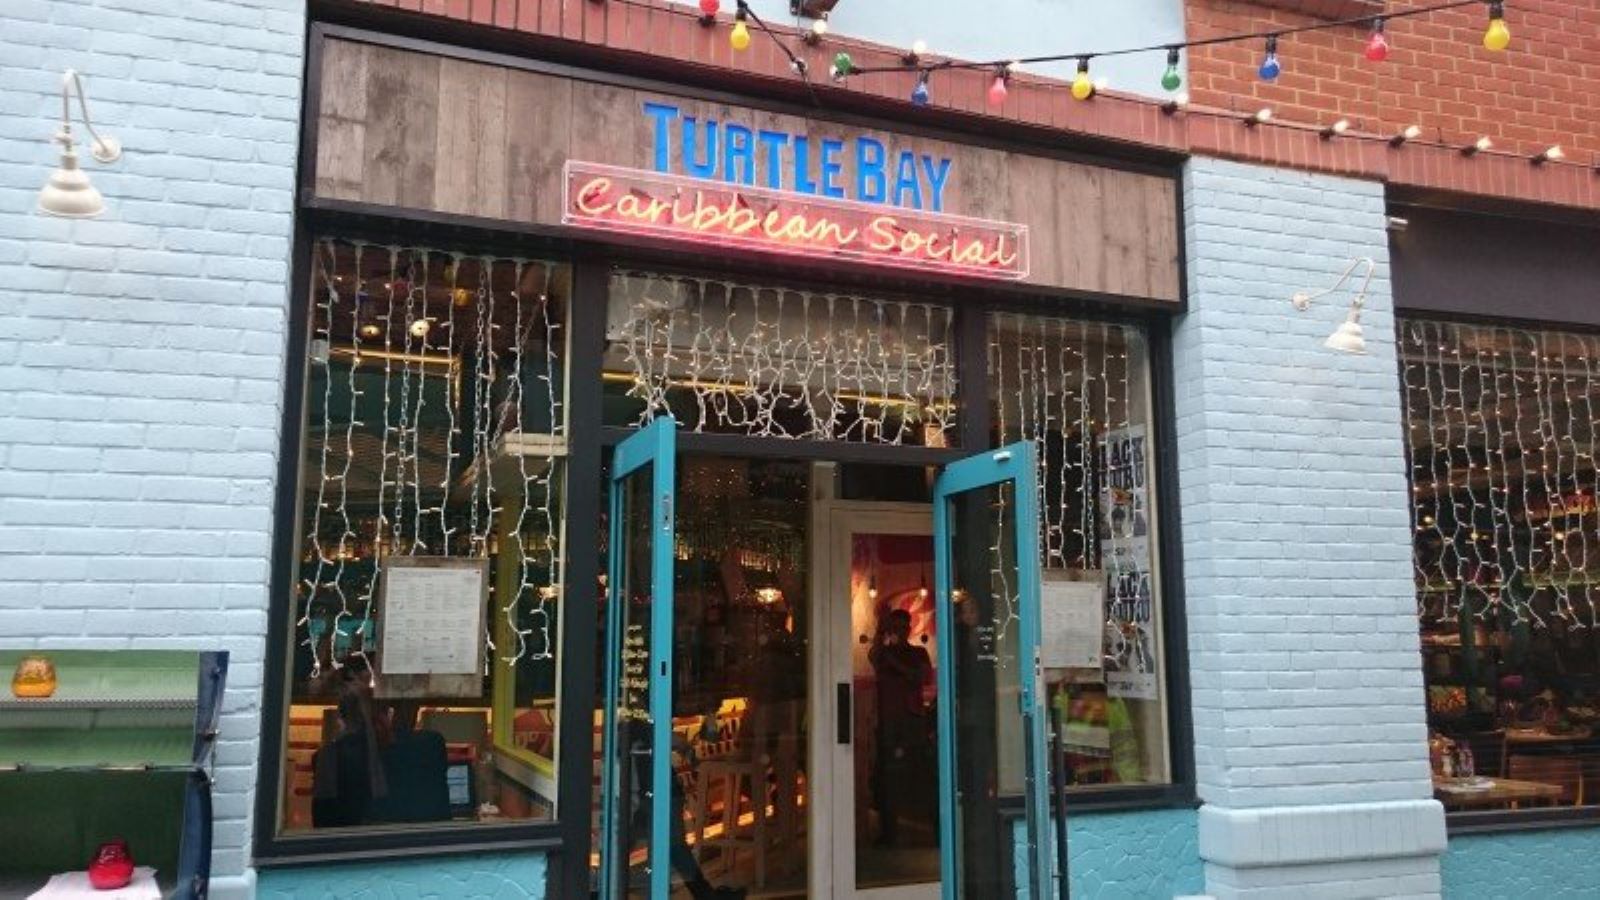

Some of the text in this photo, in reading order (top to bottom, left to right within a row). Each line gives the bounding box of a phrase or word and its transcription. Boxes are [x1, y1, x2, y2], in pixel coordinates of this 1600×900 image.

[643, 101, 951, 212] TURTLE BAY
[577, 176, 1017, 266] Caribbean Social
